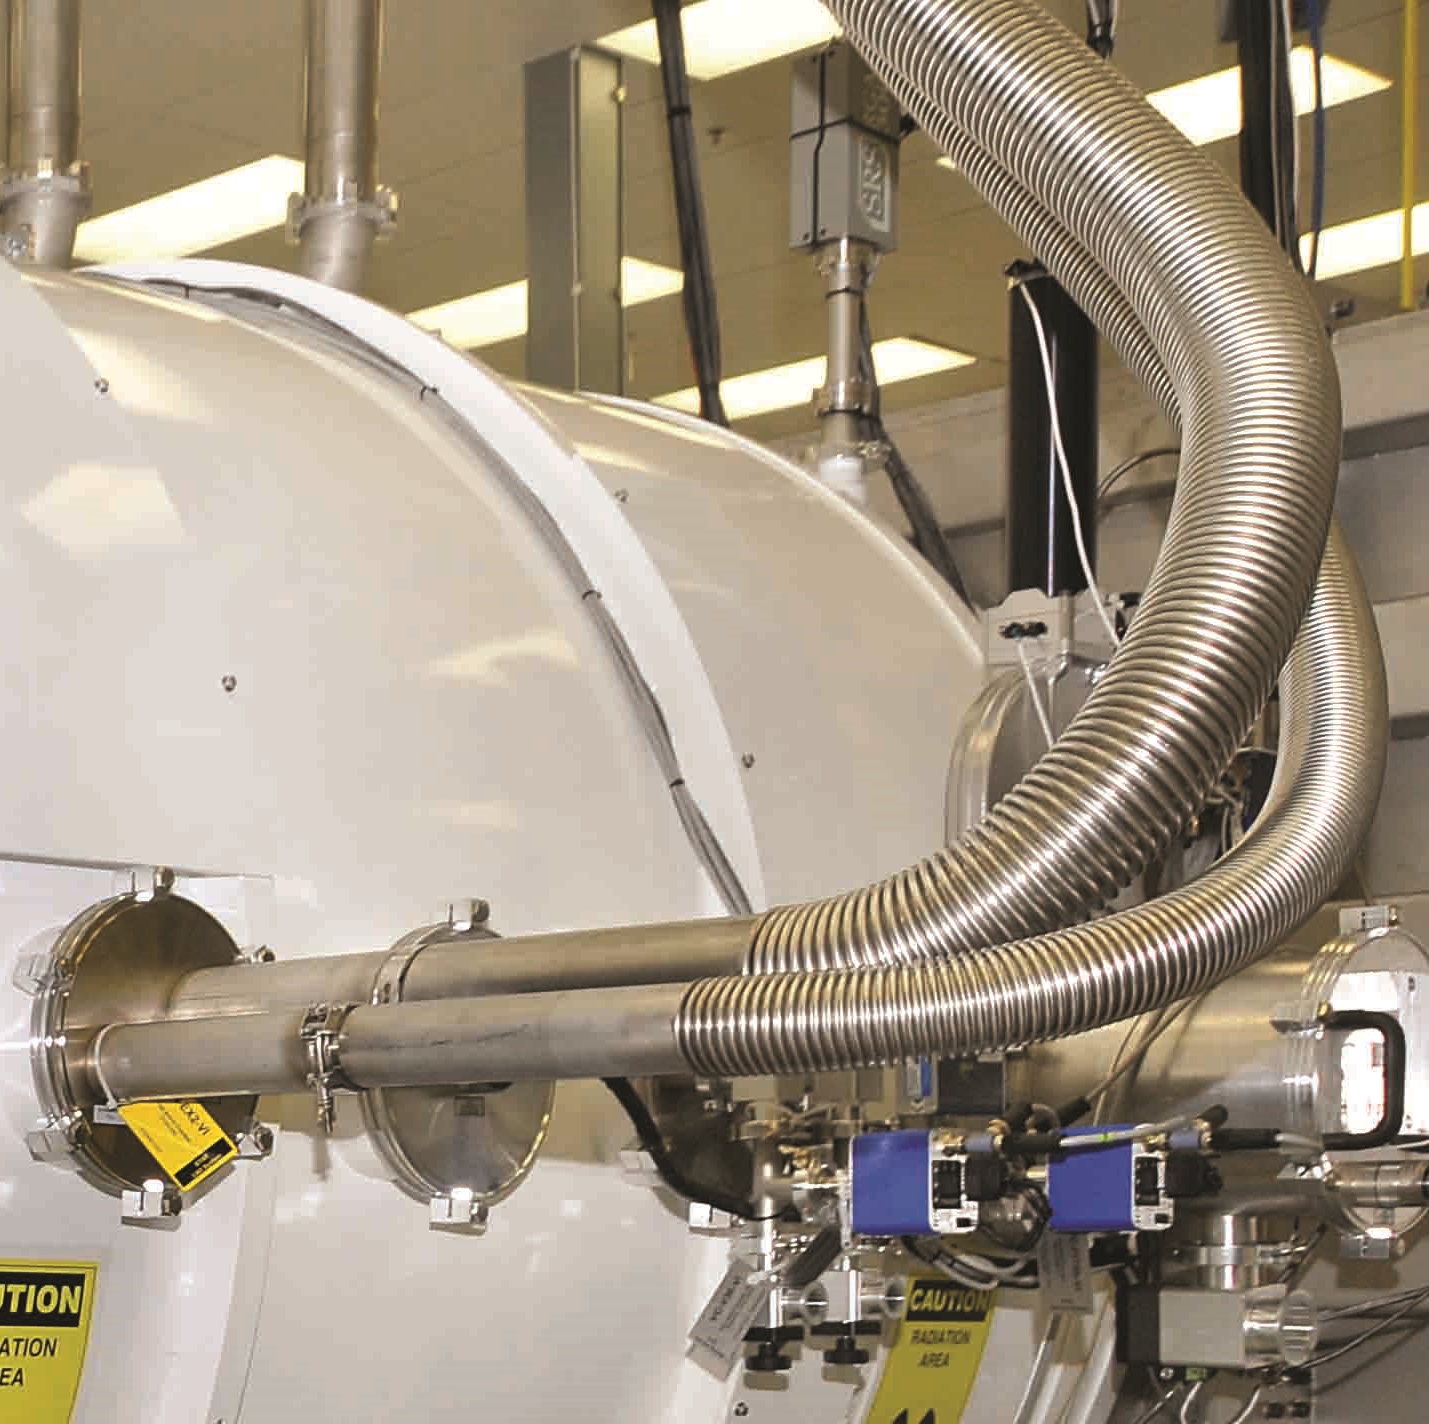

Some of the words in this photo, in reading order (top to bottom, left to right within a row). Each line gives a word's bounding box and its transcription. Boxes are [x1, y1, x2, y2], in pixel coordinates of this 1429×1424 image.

[910, 1287, 991, 1312] CAUTION
[910, 1328, 971, 1345] RADIATION
[917, 1351, 950, 1368] AREA
